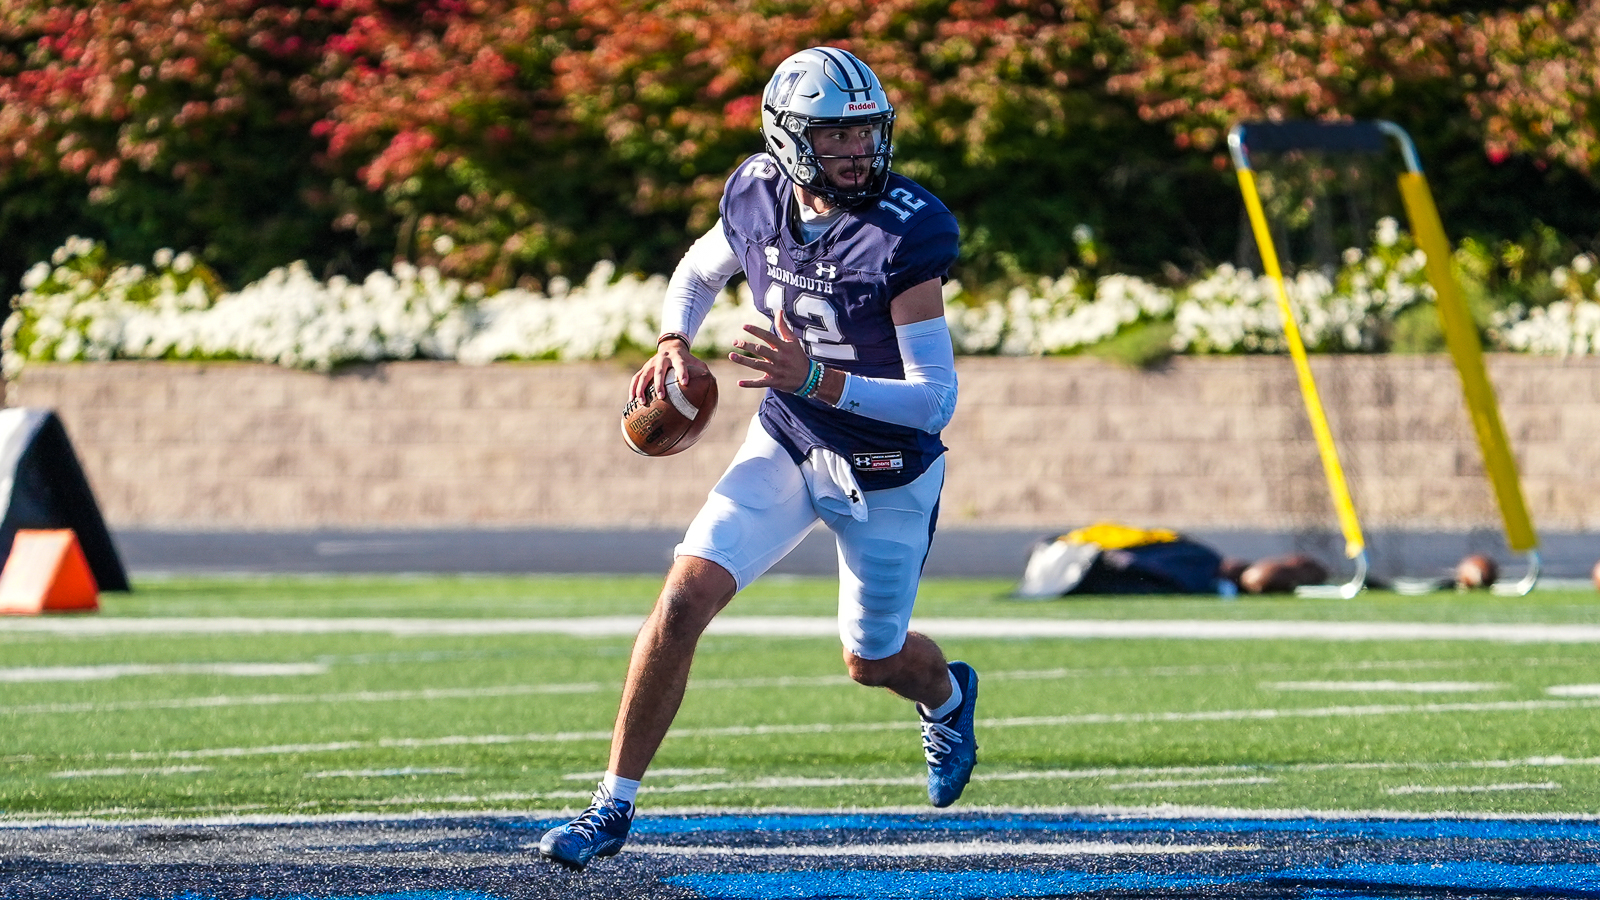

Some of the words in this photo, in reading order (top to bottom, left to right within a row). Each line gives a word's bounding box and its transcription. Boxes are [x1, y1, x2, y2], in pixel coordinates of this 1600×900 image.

[848, 102, 876, 111] Riddell
[871, 143, 886, 168] Ridell
[878, 187, 928, 222] 12
[767, 264, 833, 294] MONMOUTH
[630, 408, 661, 433] Wilson
